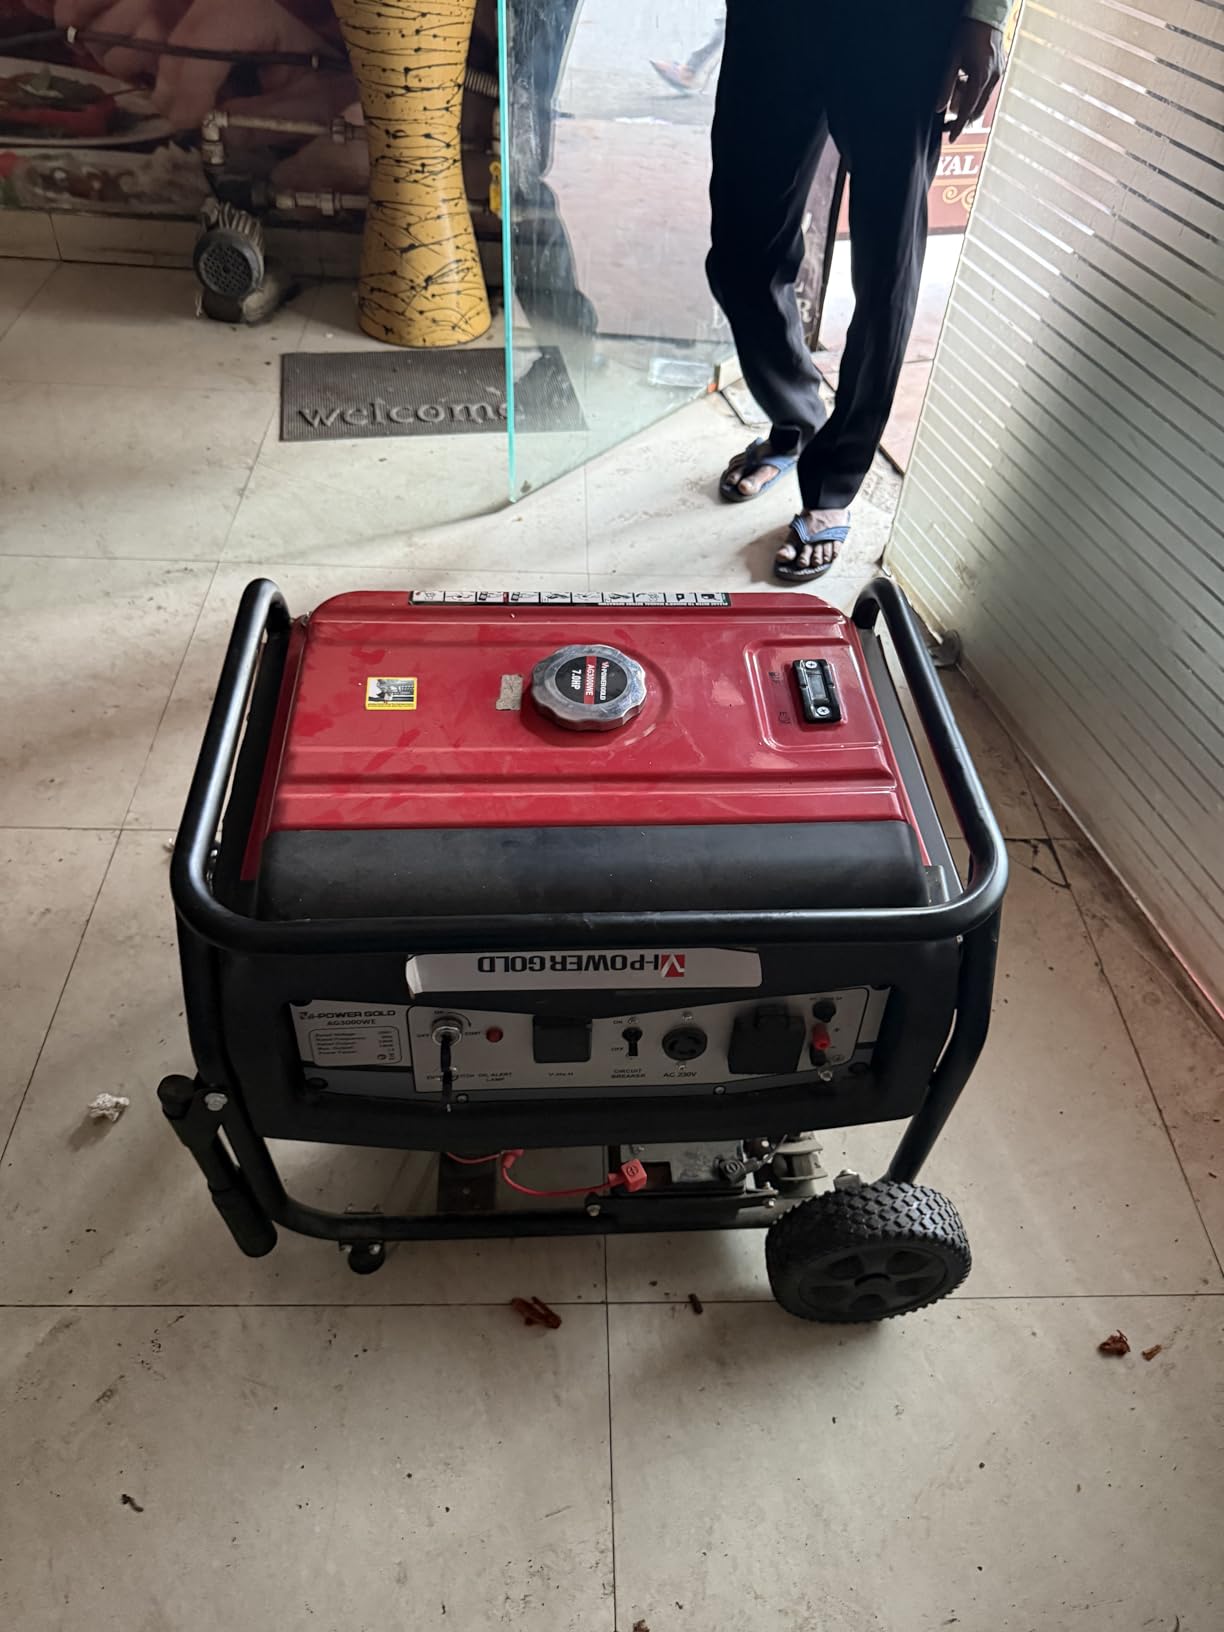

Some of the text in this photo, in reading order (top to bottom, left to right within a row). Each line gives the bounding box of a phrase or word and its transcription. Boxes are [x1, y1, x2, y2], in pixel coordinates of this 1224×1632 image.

[299, 398, 524, 429] welcome
[570, 669, 582, 690] 7.0HP
[477, 956, 546, 973] GOLD
[363, 1009, 396, 1017] GOLD
